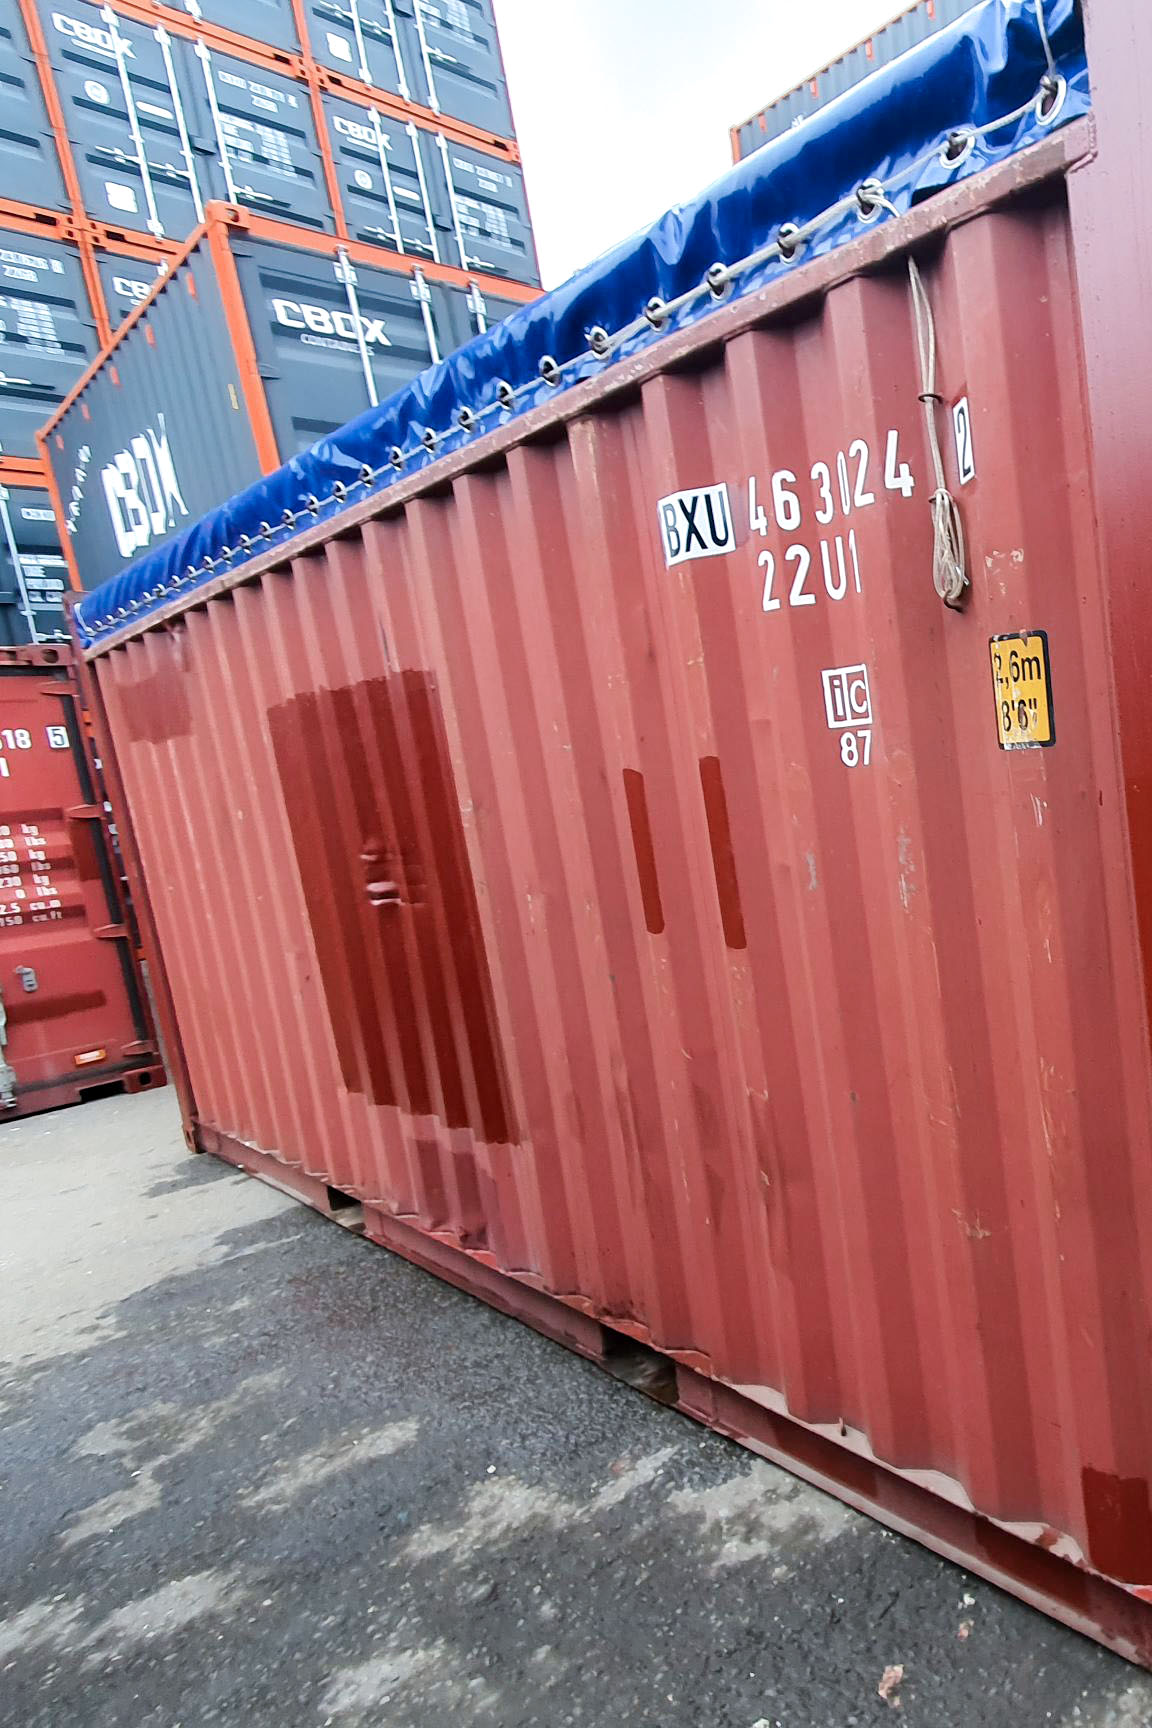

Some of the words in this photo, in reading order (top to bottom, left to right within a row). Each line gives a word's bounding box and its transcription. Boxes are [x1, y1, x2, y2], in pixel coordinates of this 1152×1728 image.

[271, 299, 392, 346] CBOX
[954, 404, 974, 477] 2
[758, 529, 862, 612] 22U1
[0, 729, 32, 749] 18
[840, 730, 873, 767] 87
